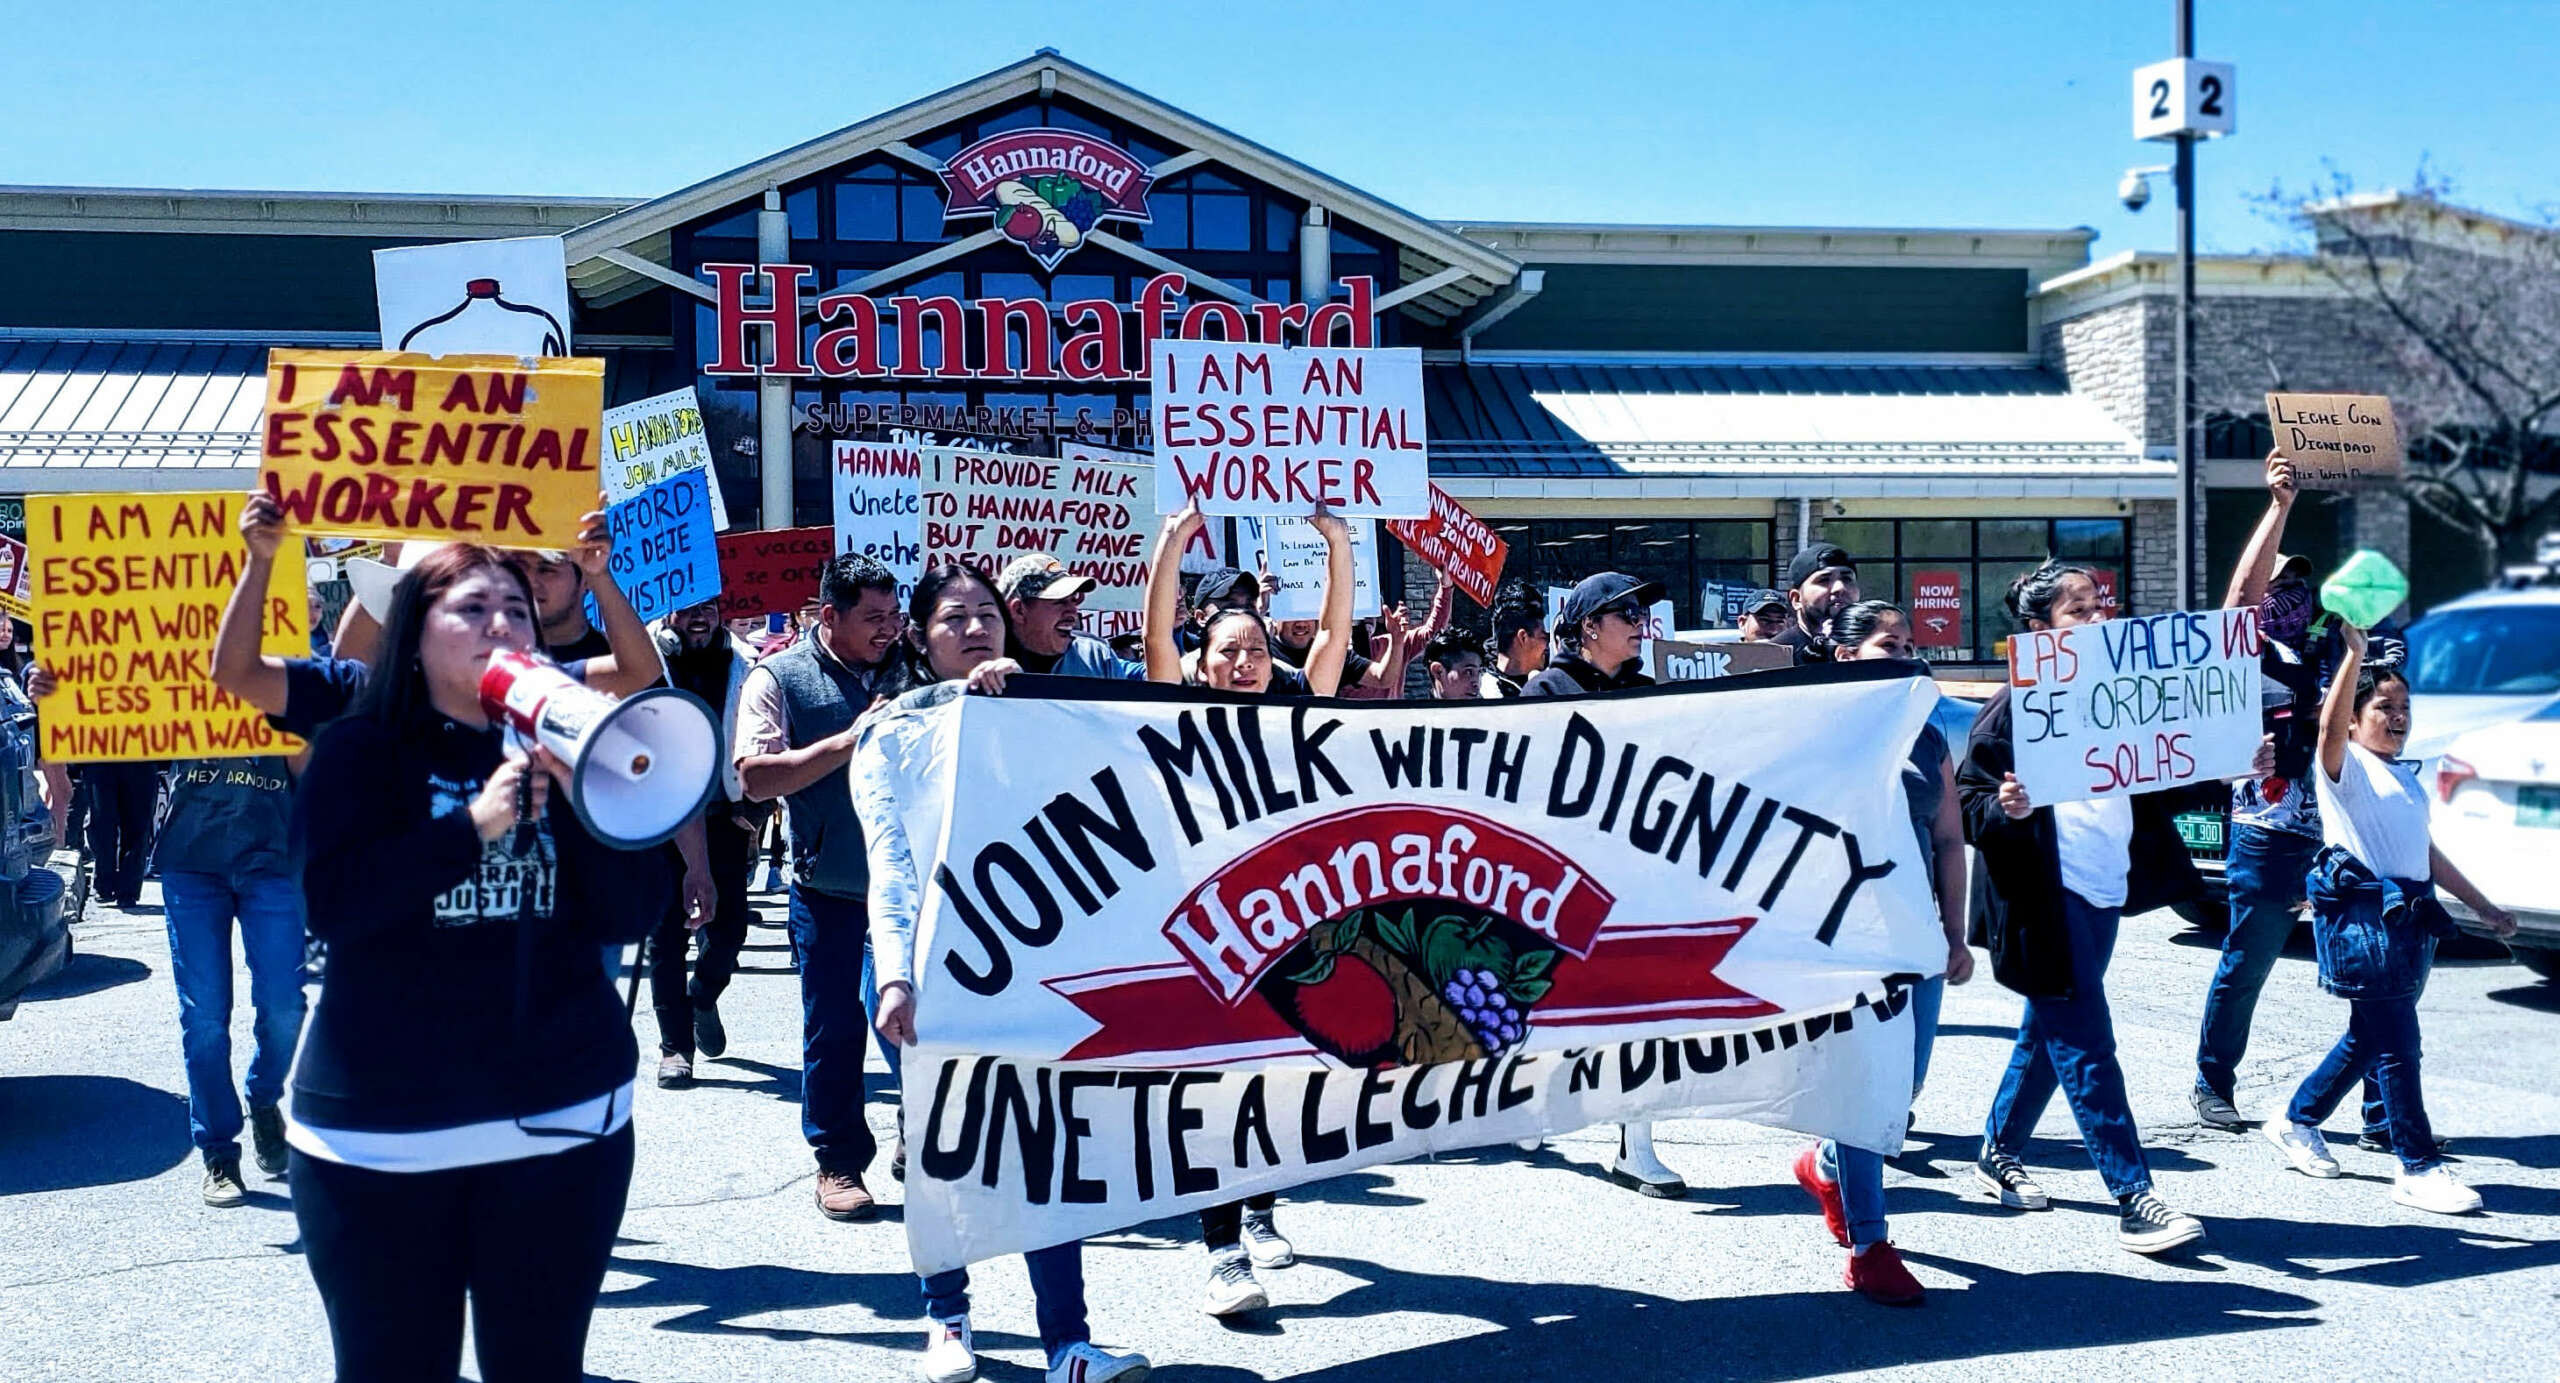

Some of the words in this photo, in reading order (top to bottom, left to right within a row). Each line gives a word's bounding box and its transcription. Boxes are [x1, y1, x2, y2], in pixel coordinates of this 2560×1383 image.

[2151, 79, 2169, 120] 2
[2199, 75, 2222, 117] 2
[961, 145, 1132, 194] Hannaford
[278, 364, 296, 402] I
[329, 362, 416, 411] AM
[440, 373, 527, 414] AN
[1168, 353, 1176, 393] I
[1198, 352, 1272, 395] AM
[1303, 357, 1362, 397] AN
[806, 403, 1060, 436] SUPERMARKET
[1075, 407, 1097, 436] &
[1164, 403, 1423, 450] ESSENTIAL
[267, 412, 596, 472] ESSENTIAL
[623, 460, 656, 490] JOIN
[661, 446, 703, 477] MILK
[934, 454, 941, 482] I
[955, 456, 1061, 490] PROVIDE
[1071, 467, 1138, 498] MILK
[1174, 451, 1381, 506] WORKER
[53, 505, 63, 542] I
[88, 503, 150, 541] AM
[169, 498, 226, 538] AN
[266, 471, 543, 535] WORKER
[923, 492, 958, 518] TO
[967, 493, 1131, 530] HANNAFORD
[643, 522, 691, 564] DEJE
[755, 538, 833, 557] vacas
[926, 522, 985, 550] BUT
[996, 525, 1069, 552] DONT
[1077, 532, 1145, 557] HAVE
[1386, 519, 1418, 542] ILK
[1420, 529, 1447, 562] WITH
[1448, 551, 1491, 602] DIGNITY!
[1439, 521, 1472, 559] JOIN
[1914, 598, 1960, 609] HIRING
[1920, 585, 1954, 597] NOW
[42, 607, 142, 648] FARM
[151, 597, 299, 641] WORR
[45, 652, 117, 684] WHO
[1667, 651, 1732, 680] milk
[2008, 629, 2079, 687] LAS
[2102, 612, 2212, 675] VACAS
[2221, 607, 2261, 660] NO
[76, 685, 150, 715] LESS
[2023, 690, 2070, 743] SE
[2090, 665, 2249, 730] ORDEÑAN
[51, 720, 197, 756] MINIMUM
[187, 769, 220, 783] HEY
[226, 771, 287, 793] ARNOLD!
[2084, 734, 2196, 792] SOLAS
[932, 765, 1156, 996] JOIN
[1136, 705, 1353, 847] MILK
[1369, 725, 1531, 803] WITH
[1546, 711, 1898, 947] DIGNITY
[435, 877, 552, 911] JUSTIE
[1170, 824, 1583, 996] Hannaford
[1232, 1074, 1281, 1168] A
[1301, 1054, 1534, 1166] LECHE
